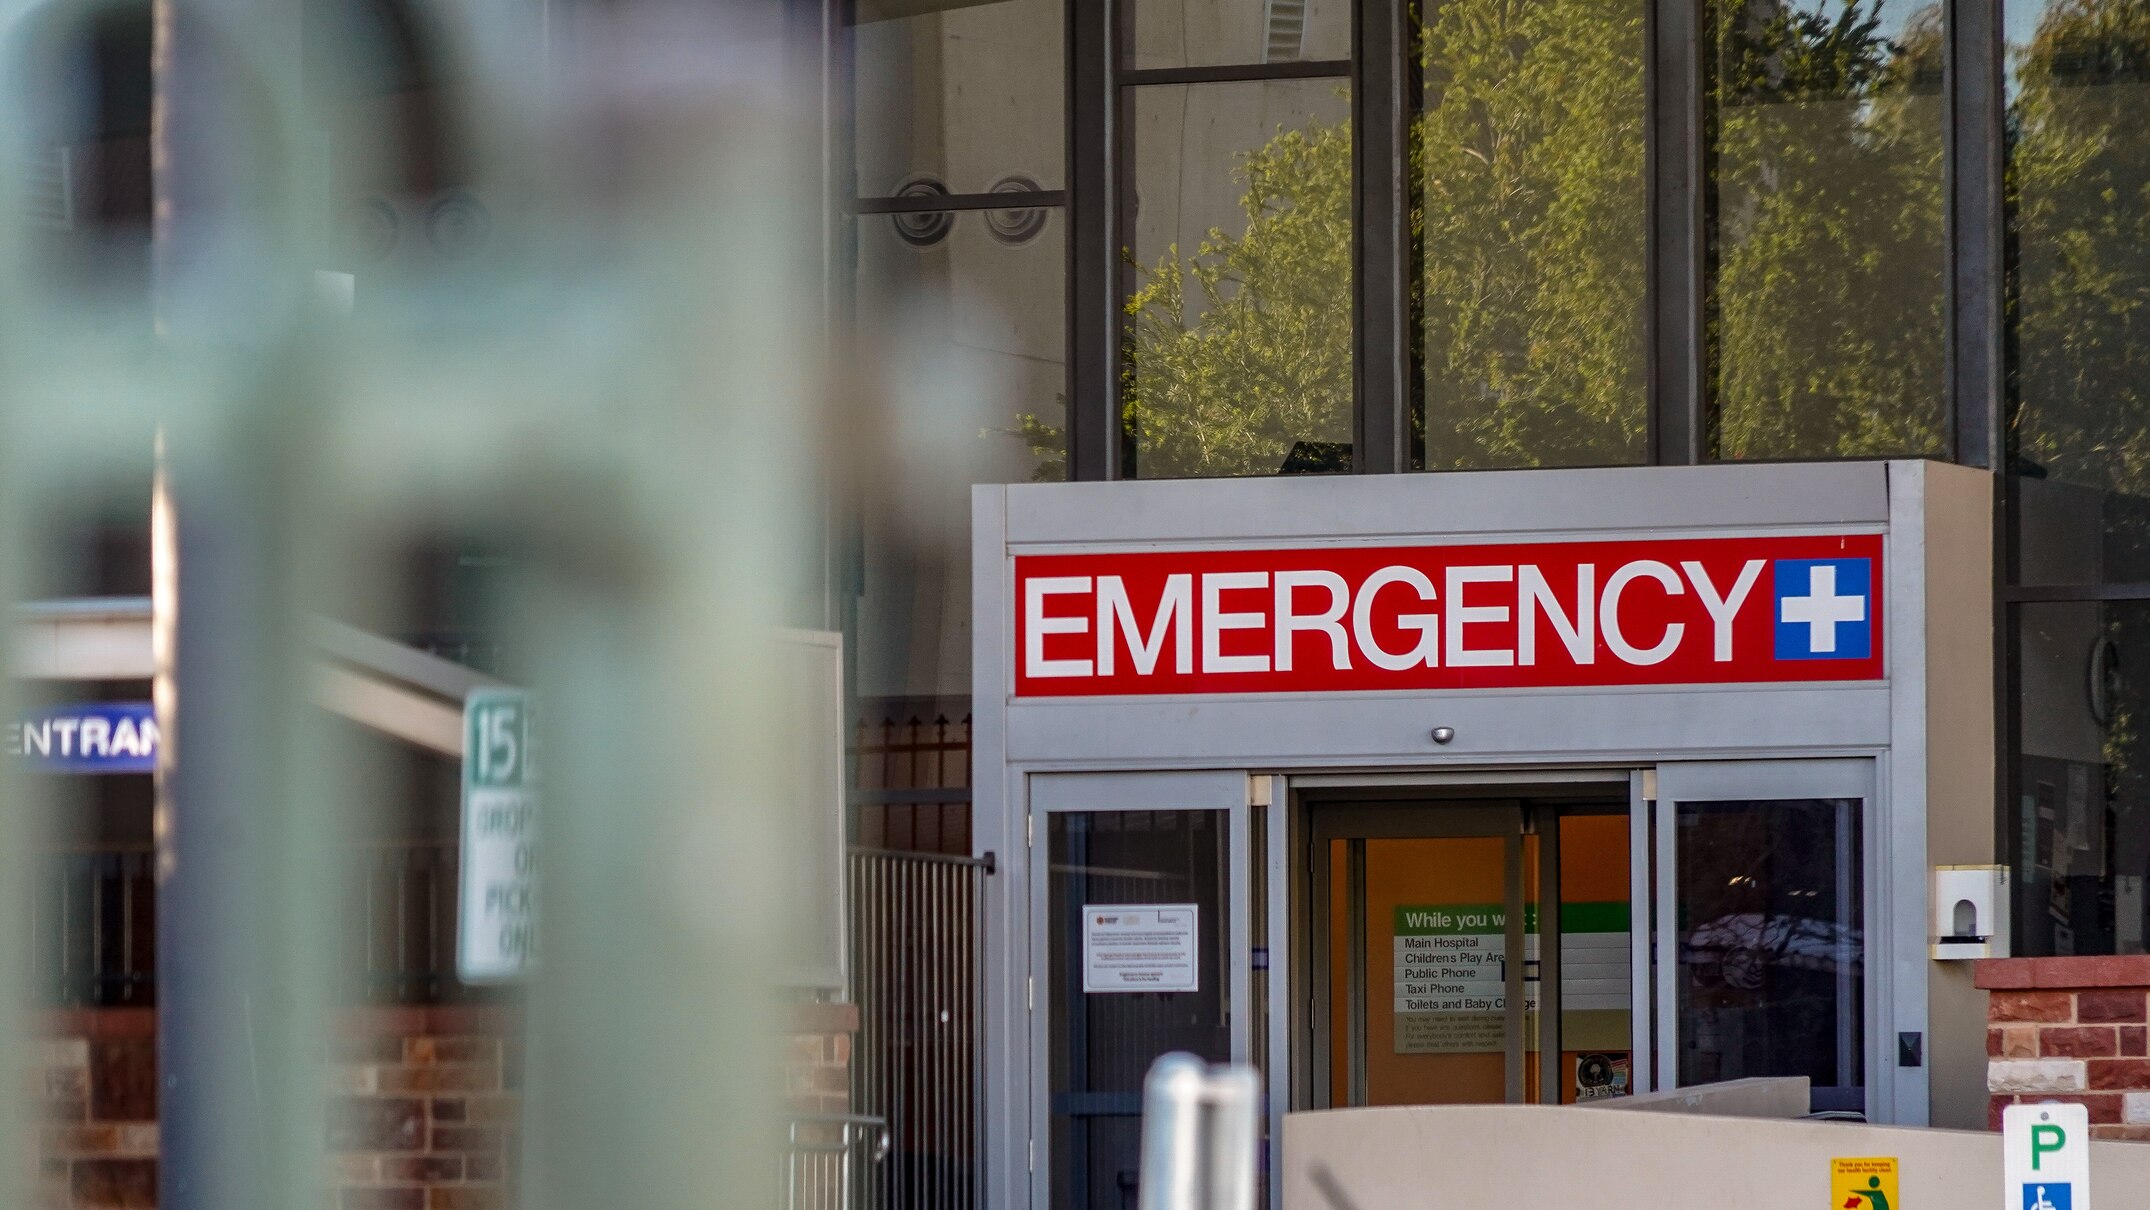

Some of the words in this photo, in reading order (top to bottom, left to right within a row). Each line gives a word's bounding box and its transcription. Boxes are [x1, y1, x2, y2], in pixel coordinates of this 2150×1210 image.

[1024, 558, 1767, 679] EMERGENCY
[6, 716, 161, 758] ENTRAN
[477, 707, 517, 780] 15
[1406, 912, 1452, 928] While
[1457, 915, 1487, 931] you
[1405, 938, 1431, 948] Main
[1435, 938, 1479, 949] Hospital
[1460, 953, 1482, 965] Play
[1486, 953, 1505, 962] Are
[1405, 969, 1437, 978] Public
[1442, 968, 1476, 978] Phone
[1406, 984, 1426, 994] Taxi
[1430, 984, 1465, 993] Phone
[1406, 999, 1439, 1010] Toilets
[1442, 999, 1461, 1009] and
[1465, 999, 1492, 1010] Baby
[2031, 1124, 2066, 1170] P
